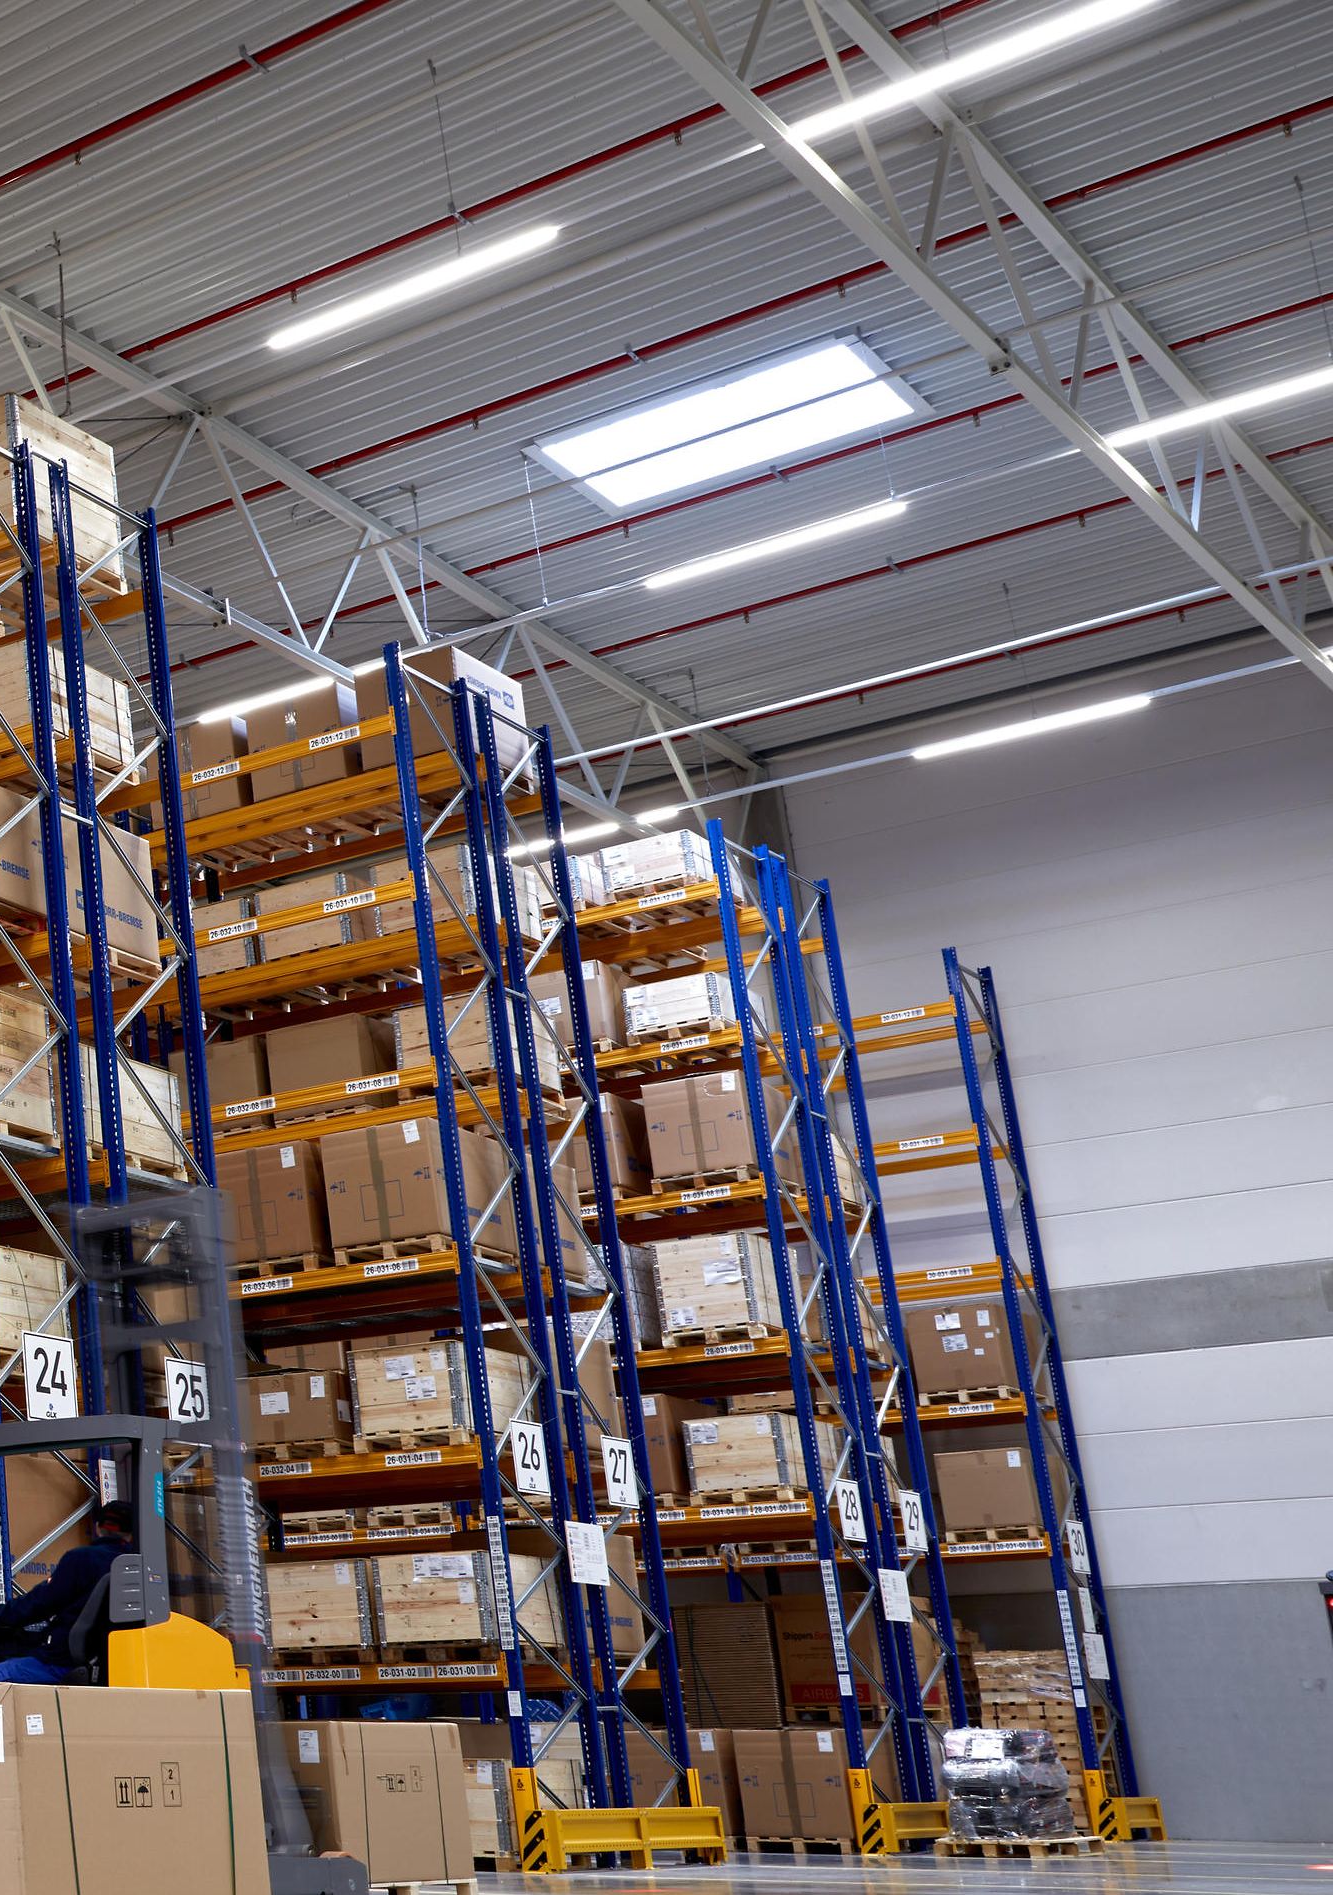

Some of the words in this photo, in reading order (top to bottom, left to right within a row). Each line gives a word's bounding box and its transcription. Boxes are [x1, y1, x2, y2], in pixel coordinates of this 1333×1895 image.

[310, 731, 344, 748] 26-031-12
[193, 766, 225, 782] 26-032-12
[324, 897, 359, 912] 26-031-10
[210, 925, 243, 939] 26-032-10
[347, 1077, 382, 1092] 26-031-08
[226, 1102, 260, 1116] 26-032-08
[365, 1261, 401, 1275] 26-031-06
[242, 1281, 276, 1293] 26-032-06
[33, 1347, 68, 1397] 24
[175, 1372, 205, 1419] 25
[518, 1431, 541, 1471] 26
[386, 1454, 423, 1465] 26-031-04
[609, 1447, 628, 1485] 27
[260, 1464, 295, 1476] 26-032-04
[702, 1507, 734, 1517] 28-031-04
[754, 1503, 788, 1514] 28-031-00
[841, 1489, 859, 1521] 28
[905, 1501, 920, 1531] 29
[1072, 1529, 1085, 1557] 30
[241, 1476, 268, 1646] JUNGHEINRICH
[305, 1668, 341, 1680] 26-032-00
[379, 1667, 417, 1678] 26-031-02
[437, 1664, 476, 1676] 26-031-00
[802, 1688, 864, 1700] AIRBAS
[168, 1768, 173, 1780] 2
[170, 1790, 175, 1800] 1
